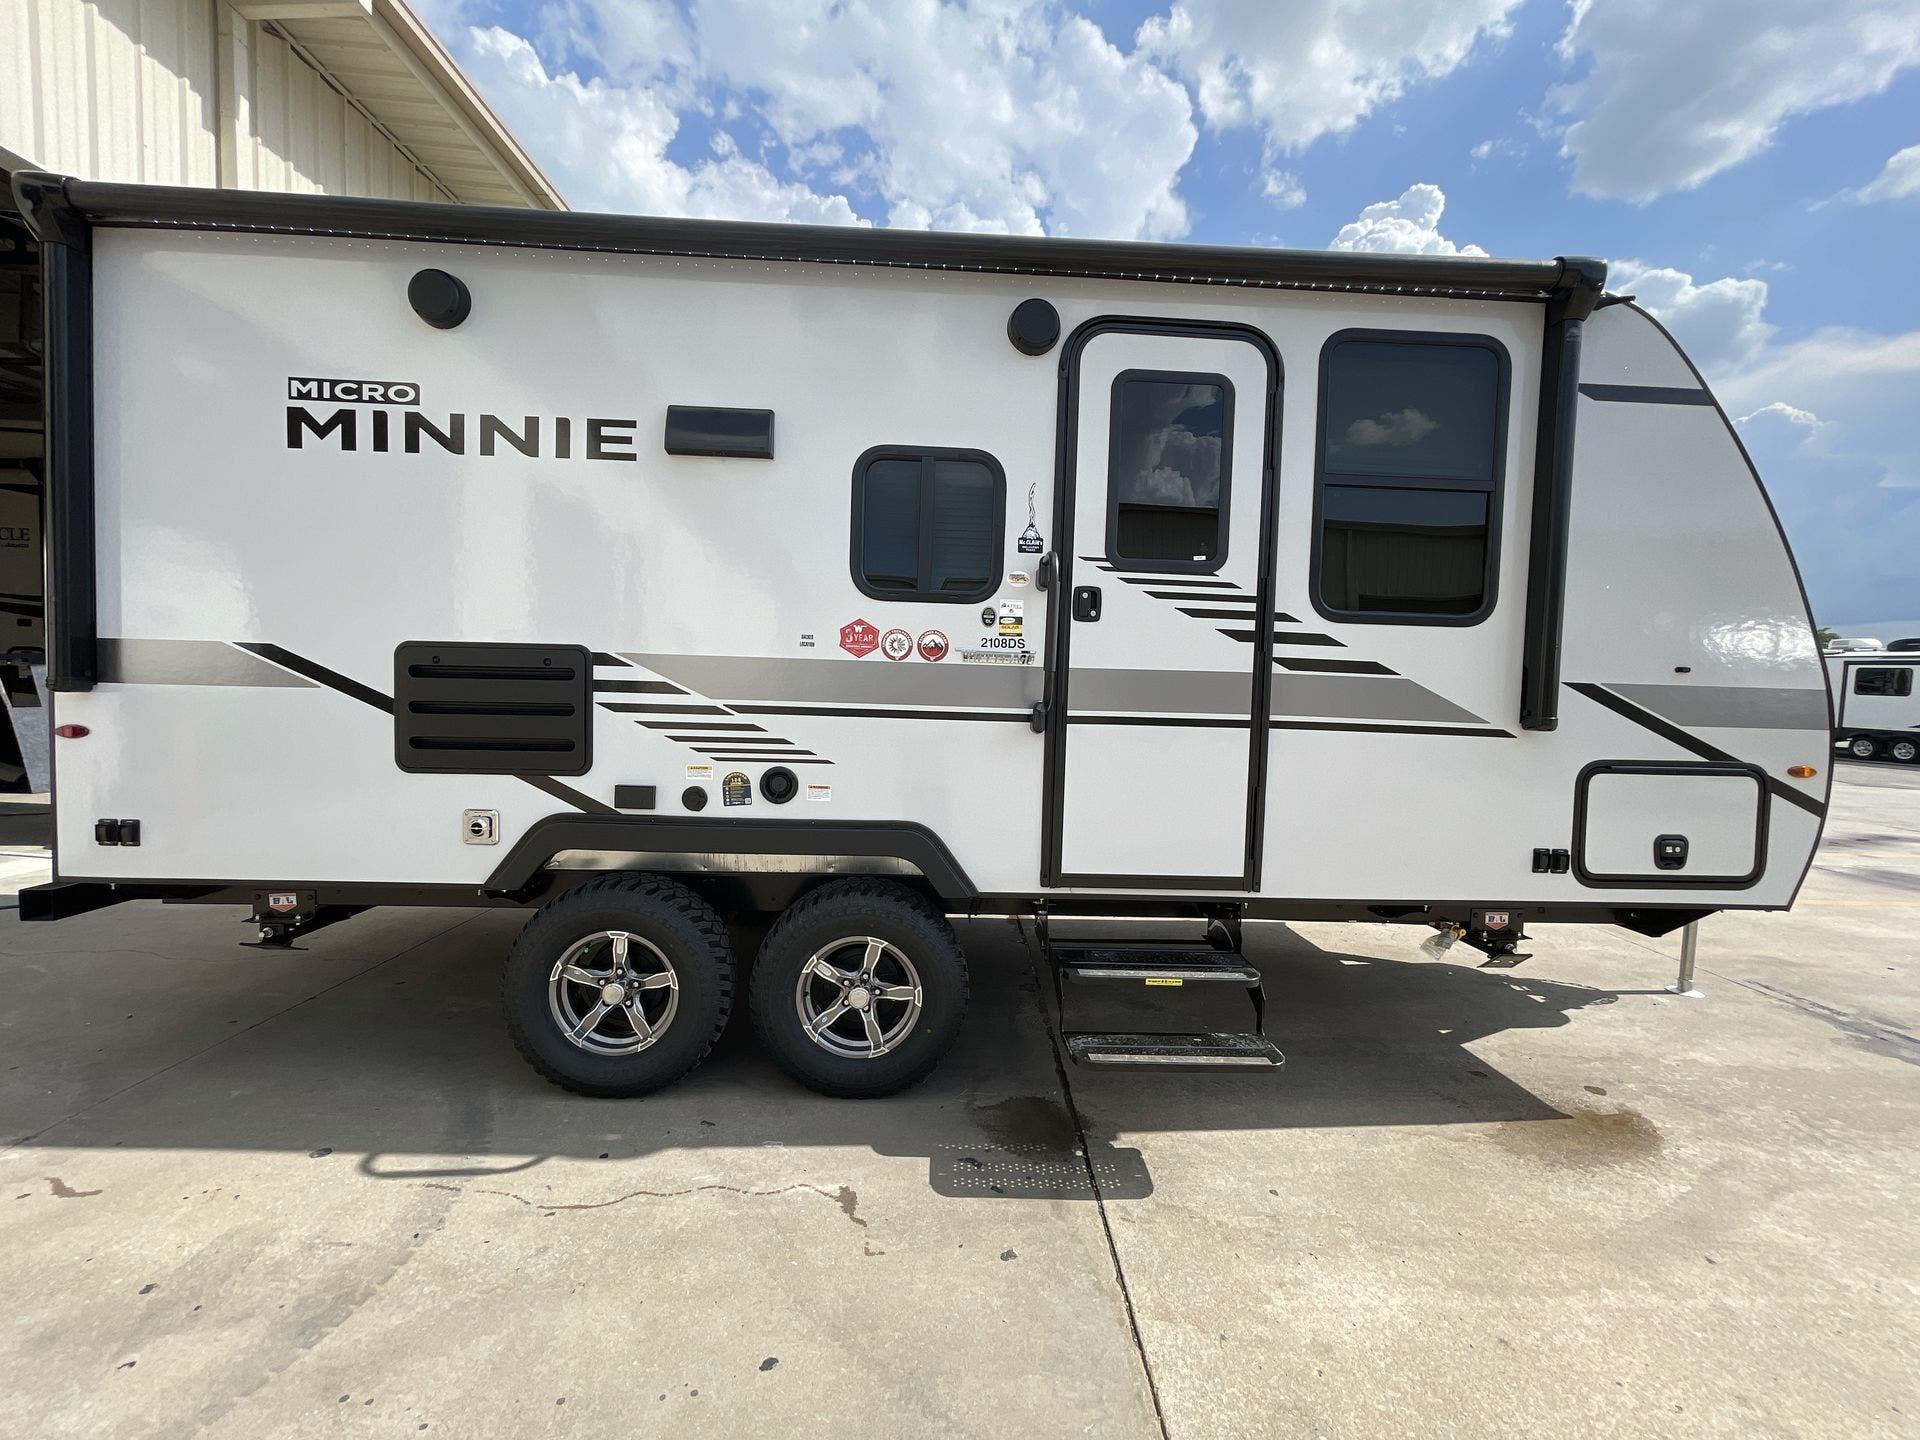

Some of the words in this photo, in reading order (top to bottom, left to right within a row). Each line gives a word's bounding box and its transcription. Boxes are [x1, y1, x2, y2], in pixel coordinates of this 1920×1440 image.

[290, 380, 416, 403] MICRO
[286, 406, 637, 462] MINNIE
[854, 634, 874, 642] YEAR
[981, 638, 1026, 649] 2108DS
